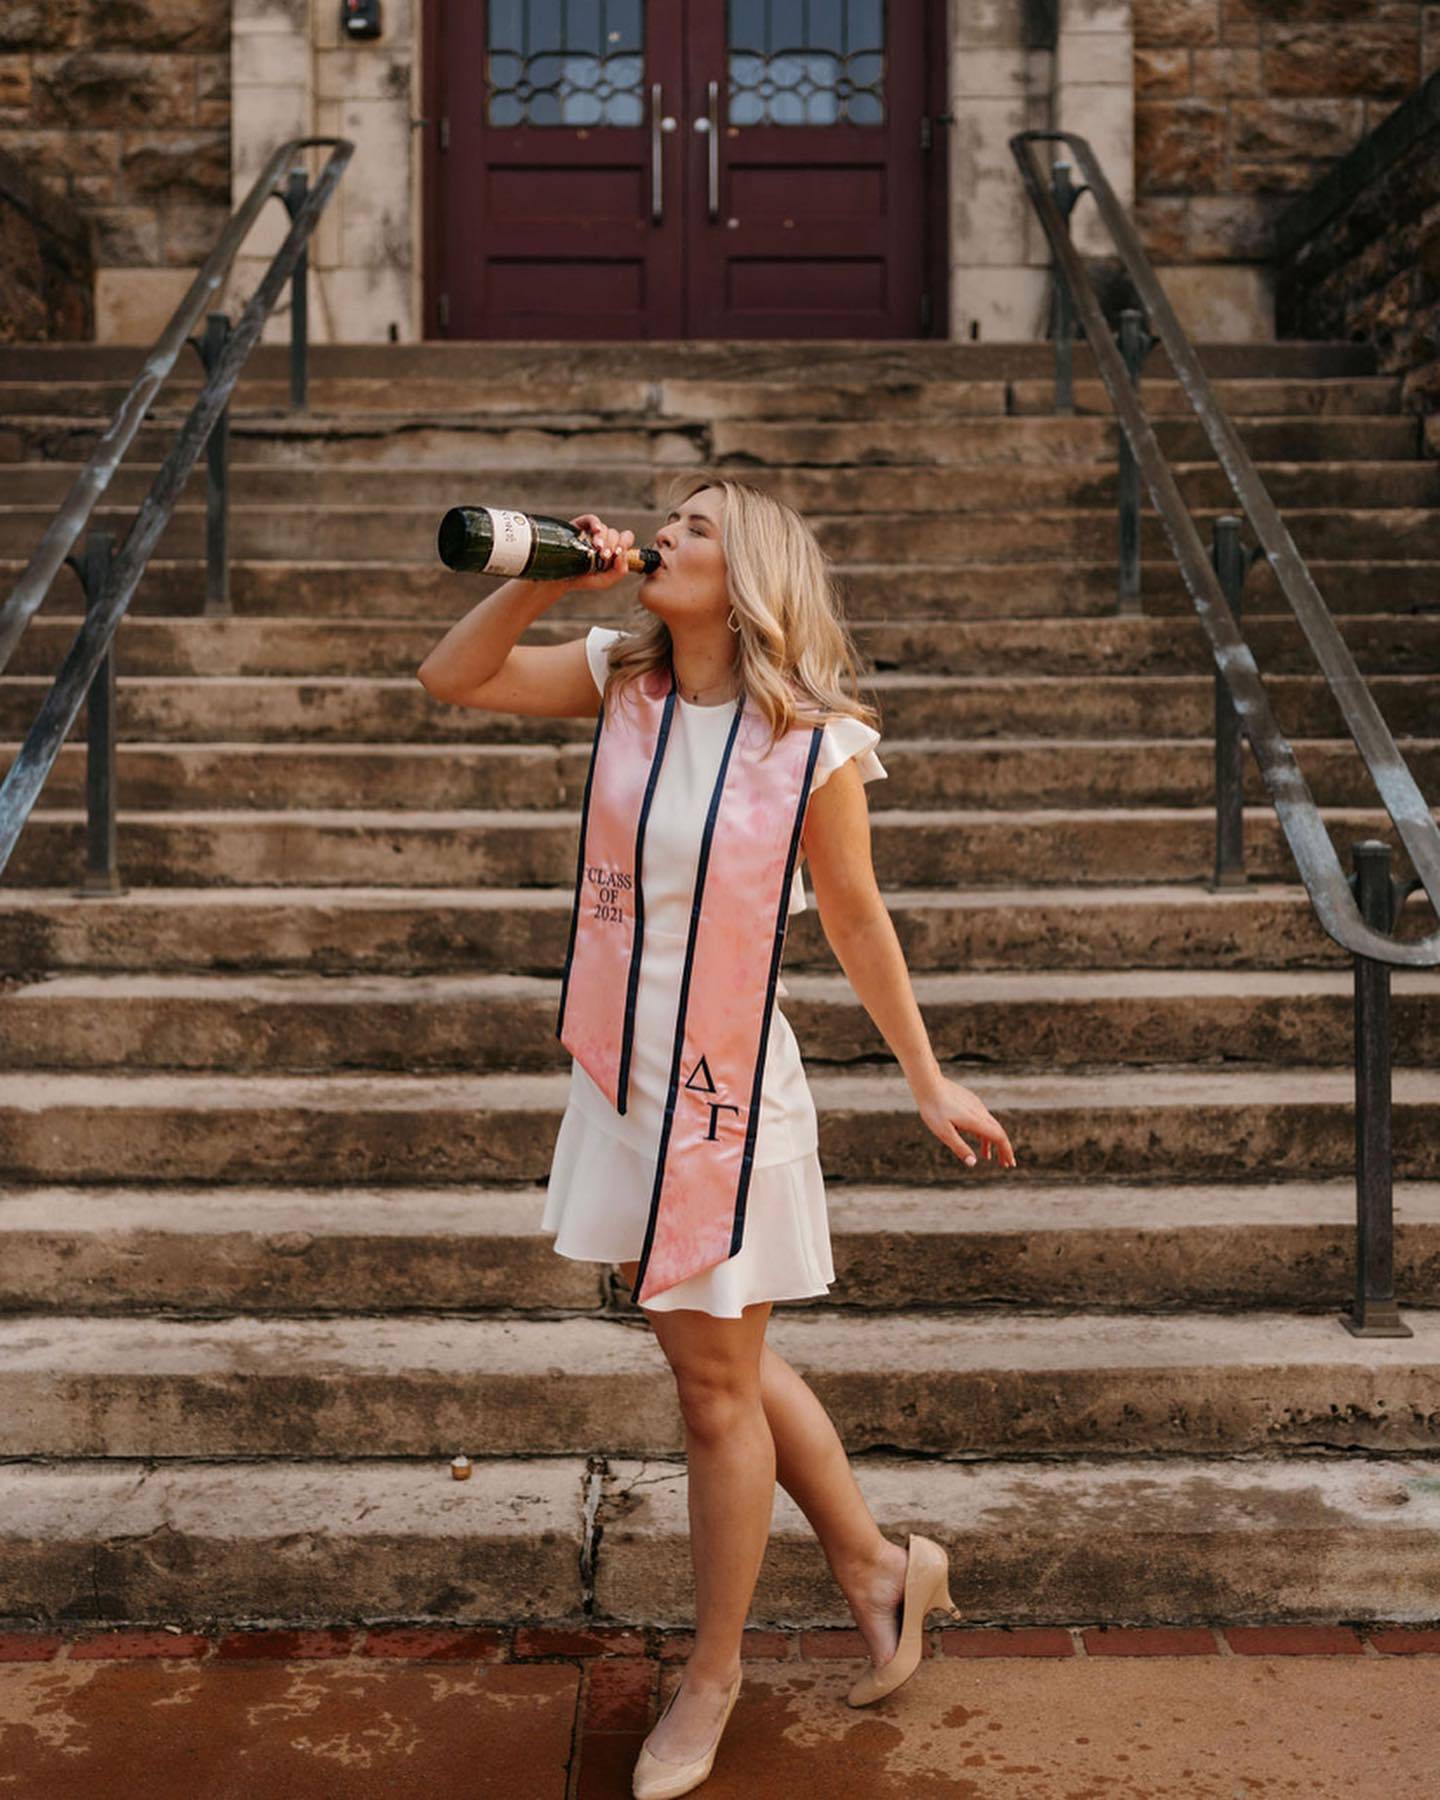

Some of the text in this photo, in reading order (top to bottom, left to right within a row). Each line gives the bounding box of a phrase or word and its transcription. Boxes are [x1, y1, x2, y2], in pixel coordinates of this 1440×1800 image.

[588, 867, 632, 889] CLASS
[600, 888, 618, 904] OF
[594, 904, 623, 923] 2021
[685, 1053, 717, 1093] Δ
[703, 1102, 739, 1141] Γ
